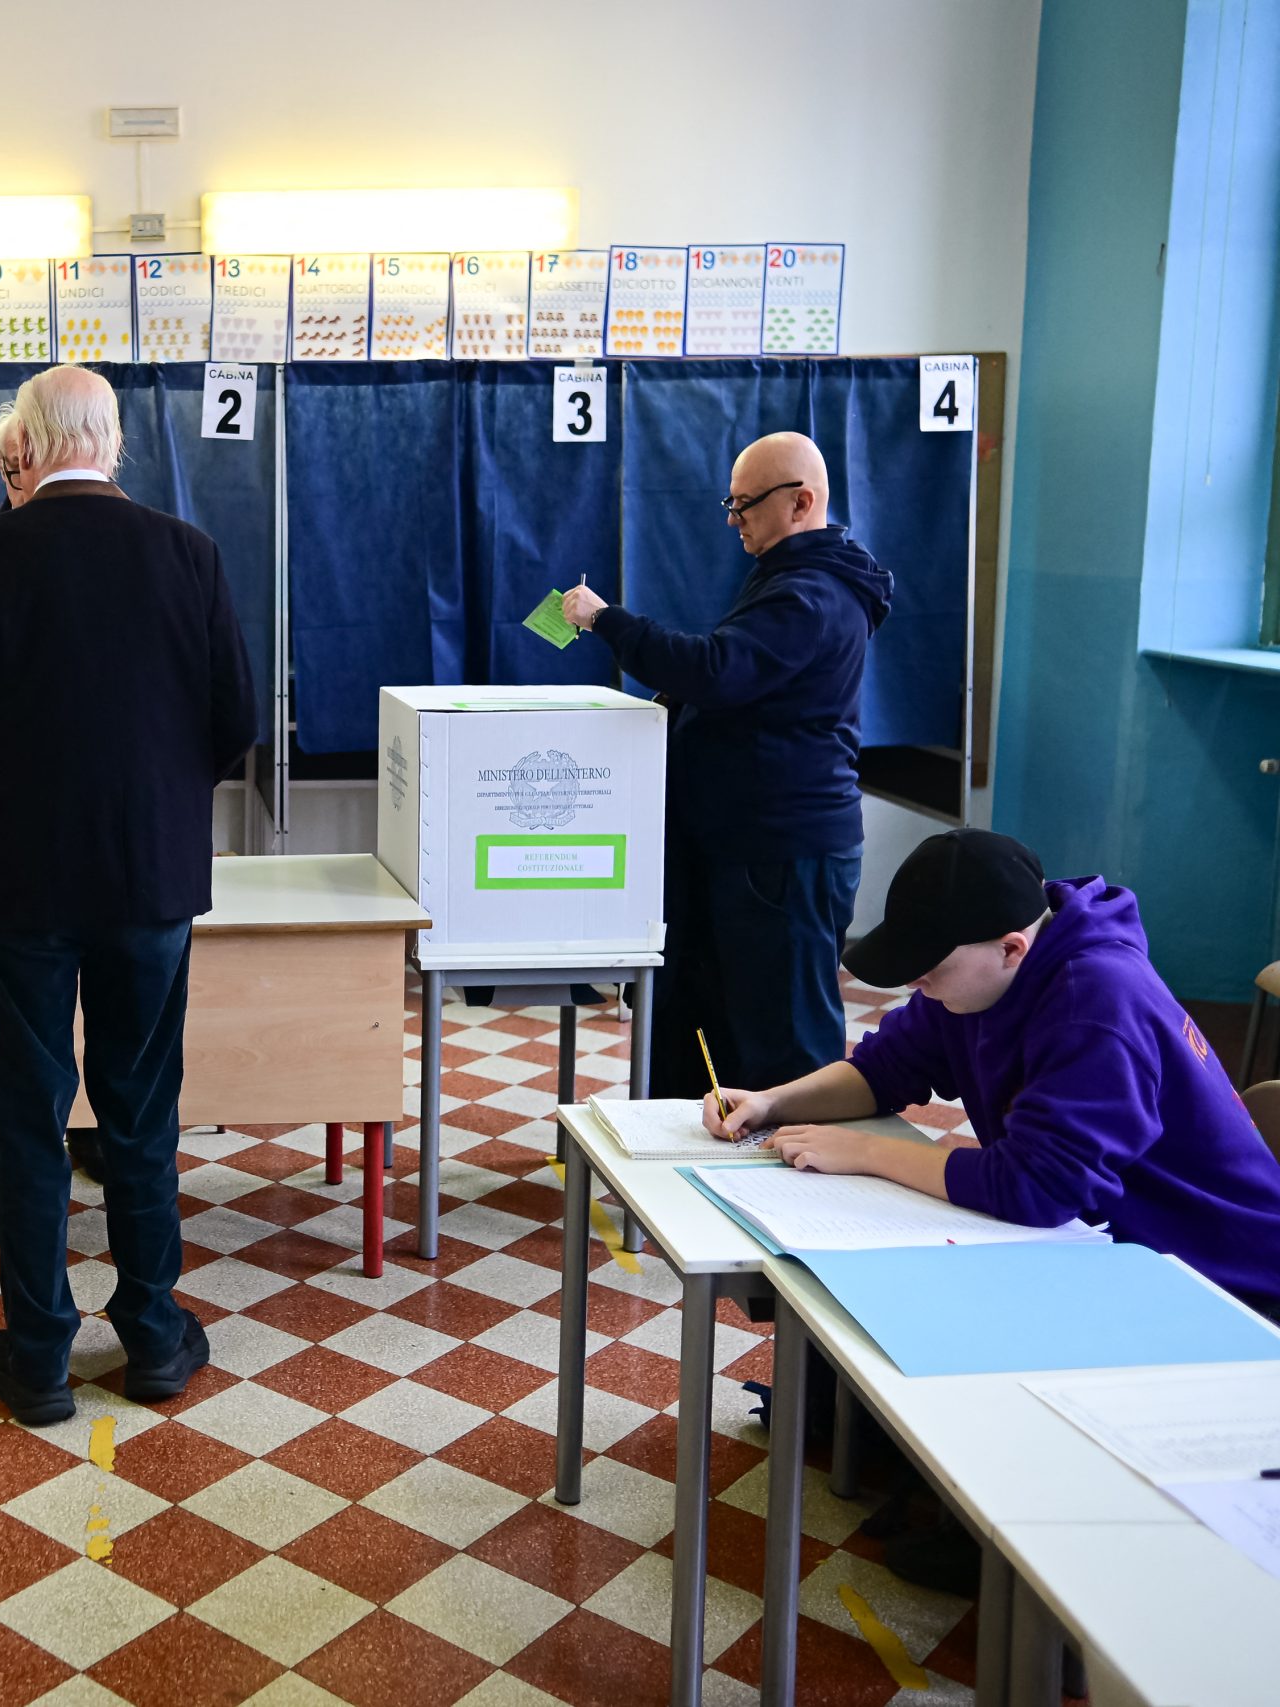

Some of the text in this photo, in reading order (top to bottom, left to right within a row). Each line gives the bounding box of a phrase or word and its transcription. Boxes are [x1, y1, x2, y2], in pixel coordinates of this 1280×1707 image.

[456, 256, 479, 275] 16
[536, 254, 560, 272] 17
[613, 252, 638, 271] 18
[692, 251, 715, 270] 19
[769, 248, 795, 268] 20
[58, 261, 79, 280] 11
[138, 260, 162, 279] 12
[217, 259, 240, 277] 13
[297, 257, 320, 276] 14
[377, 257, 400, 276] 15
[296, 284, 365, 294] QUATTORDICI
[534, 280, 605, 292] DICIASSETTE
[613, 279, 676, 290] DICIOTTO
[691, 277, 762, 288] DICIANNOVE
[769, 276, 804, 287] VENTI
[59, 287, 104, 298] UNDICI
[140, 286, 186, 297] DODICI
[217, 285, 266, 297] TREDICI
[209, 369, 253, 380] CABNA
[924, 362, 969, 372] CABINA
[933, 380, 959, 425] 4
[216, 389, 242, 434] 2
[567, 391, 592, 435] 3
[478, 767, 611, 782] MINISTERO DELL'INTERNO
[524, 853, 578, 861] REFERENDUM
[517, 864, 584, 872] COSTITUZIONALE
